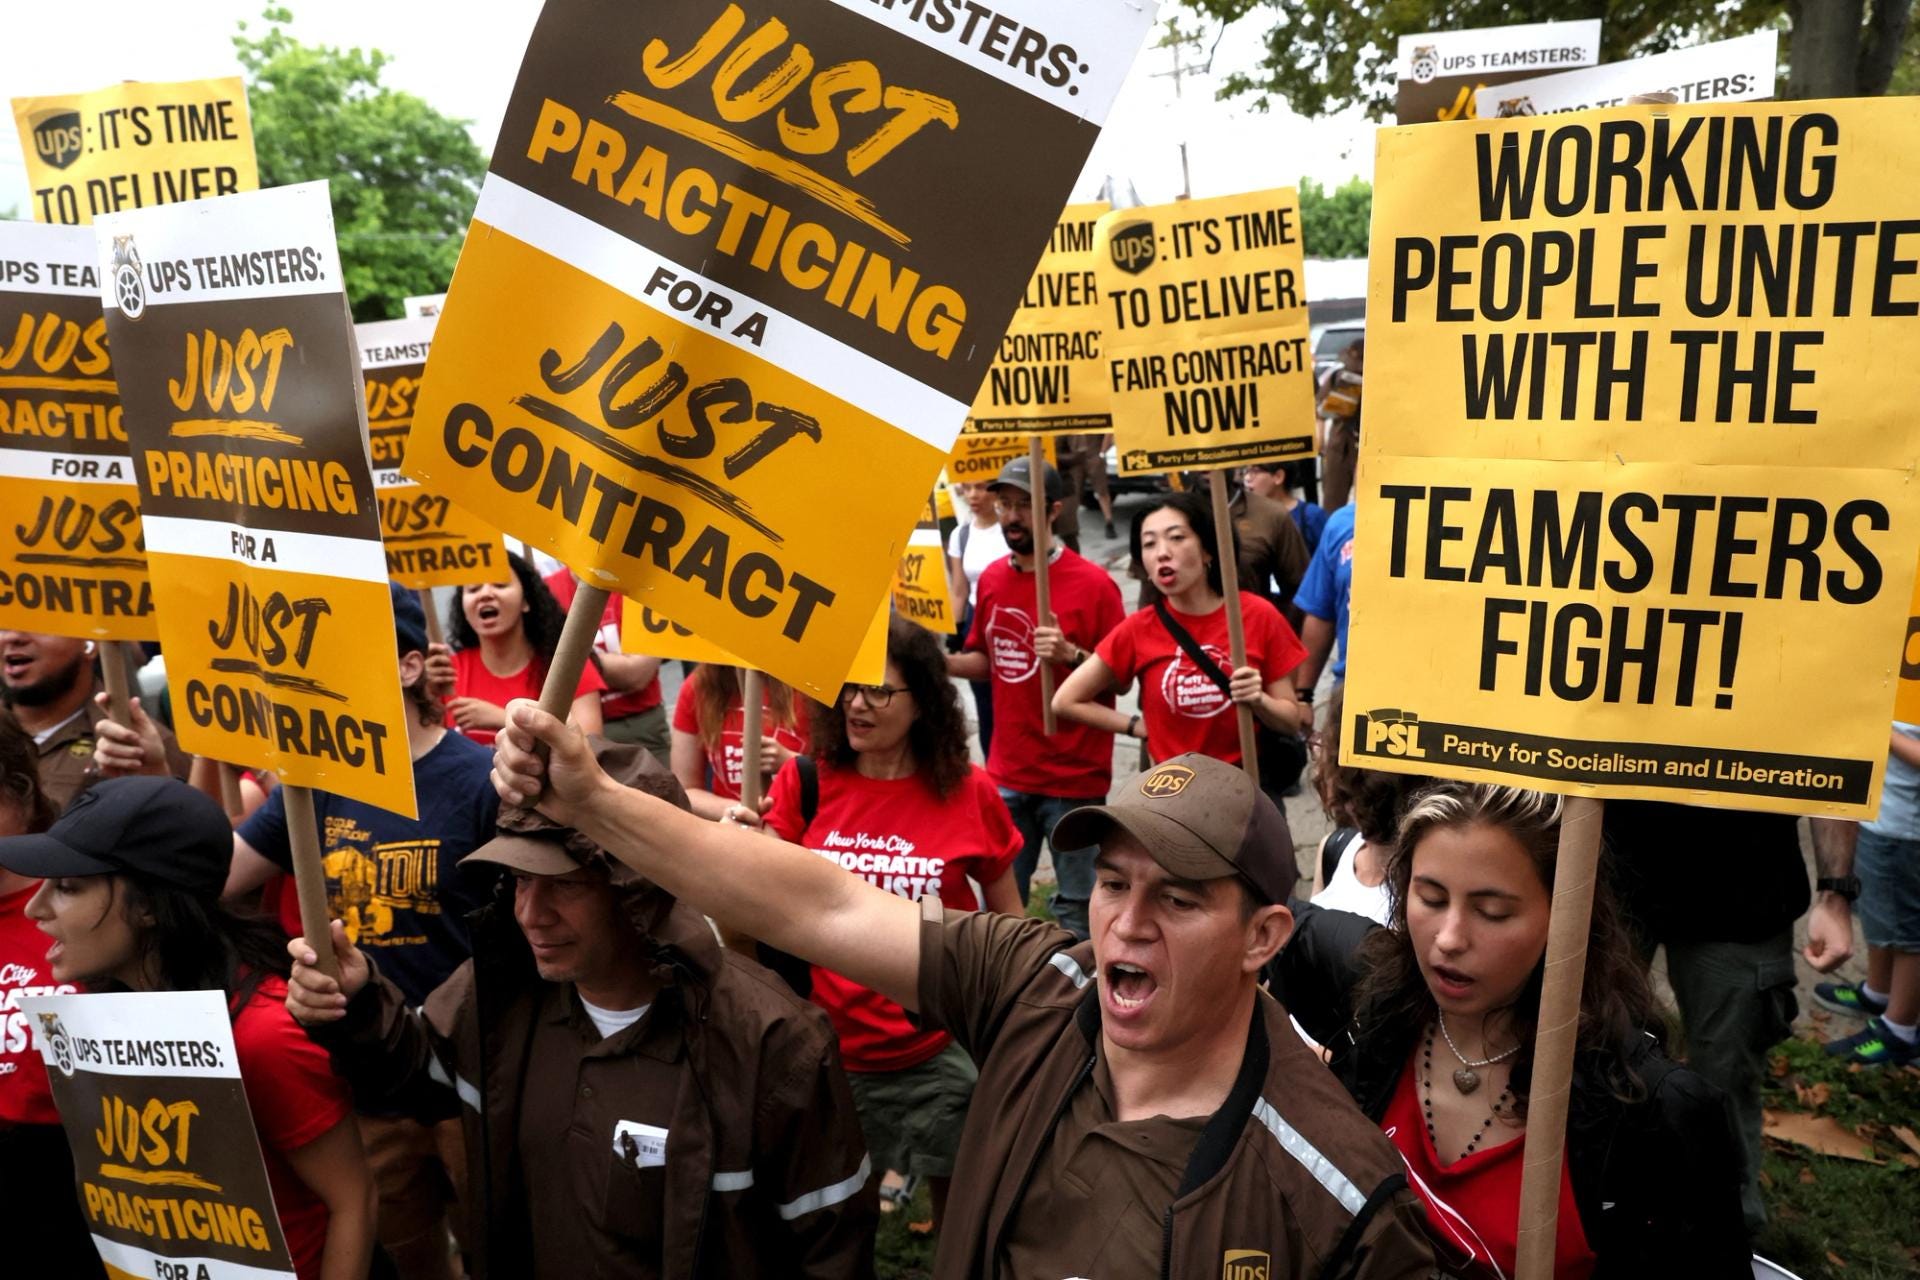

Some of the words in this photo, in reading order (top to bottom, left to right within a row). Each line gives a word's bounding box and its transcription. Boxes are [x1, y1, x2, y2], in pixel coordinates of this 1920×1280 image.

[870, 0, 1089, 96] STERS:
[1443, 53, 1476, 71] UPS
[1481, 46, 1587, 68] TEAMSTERS:
[642, 2, 959, 178] JUST
[99, 106, 152, 151] IT'S
[157, 100, 238, 143] TIME
[1475, 112, 1839, 222] WORKING
[36, 184, 80, 225] TO
[527, 98, 969, 361] PRACTICING
[1172, 218, 1221, 259] IT'S
[1225, 207, 1296, 253] TIME
[46, 263, 100, 289] TEA
[147, 260, 192, 293] UPS
[193, 246, 325, 289] TEAMSTERS:
[1108, 287, 1150, 330] TO
[1159, 269, 1308, 324] DELIVER.
[1391, 225, 1667, 323] PEOPLE
[1684, 219, 1920, 319] UNITE
[643, 267, 735, 330] FOR
[738, 310, 770, 348] A
[169, 328, 293, 414] JUST
[1000, 330, 1102, 363] CONTRAC
[1110, 353, 1169, 393] FAIR
[1172, 338, 1307, 387] CONTRACT
[1462, 330, 1649, 421] WITH
[1670, 330, 1824, 425] THE
[540, 322, 823, 480] JUST
[991, 365, 1070, 406] NOW!
[1163, 383, 1261, 436] NOW!
[52, 459, 98, 478] FOR
[105, 462, 123, 478] A
[145, 450, 358, 515] PRACTICING
[230, 530, 256, 561] FOR
[260, 537, 277, 562] A
[443, 402, 836, 643] CONTRACT
[1380, 484, 1890, 604] TEAMSTERS
[208, 582, 332, 670] JUST
[1479, 597, 1744, 710] FIGHT!
[186, 679, 388, 776] CONTRACT
[1365, 721, 1426, 759] PSL
[1443, 733, 1504, 766] Party
[1508, 742, 1543, 765] for
[1547, 752, 1658, 777] Socialism
[1664, 758, 1711, 779] and
[1715, 760, 1844, 791] Liberation
[1147, 773, 1185, 793] ups
[72, 1037, 101, 1064] UPS
[103, 1039, 224, 1068] TEAMSTERS:
[96, 1095, 199, 1166] JUST
[83, 1182, 271, 1252] PRACTICING
